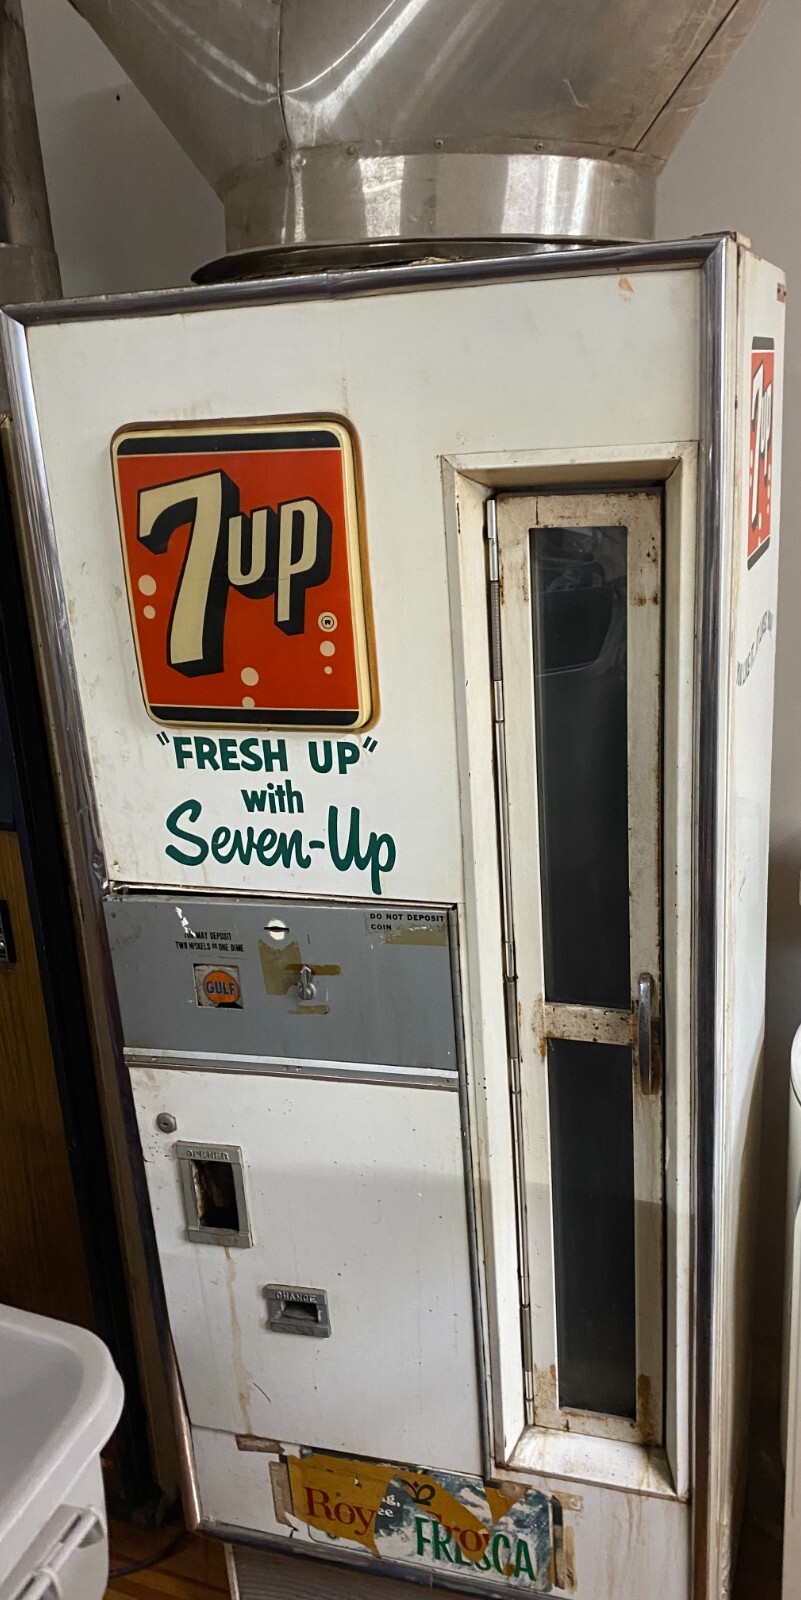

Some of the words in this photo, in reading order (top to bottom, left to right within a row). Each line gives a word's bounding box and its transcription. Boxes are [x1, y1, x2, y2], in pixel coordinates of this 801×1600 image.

[157, 732, 288, 772] "FRESH
[308, 736, 378, 774] UP"
[241, 779, 304, 813] with
[165, 799, 396, 895] Seven-Up
[386, 913, 403, 921] NOT
[407, 914, 445, 922] DEPOSIT
[370, 923, 392, 931] COIN
[175, 941, 188, 950] TWO
[218, 943, 230, 951] ONE
[230, 943, 244, 952] DIME
[206, 981, 235, 995] GULF
[186, 1149, 230, 1161] OPENER
[276, 1291, 317, 1303] CHANGE
